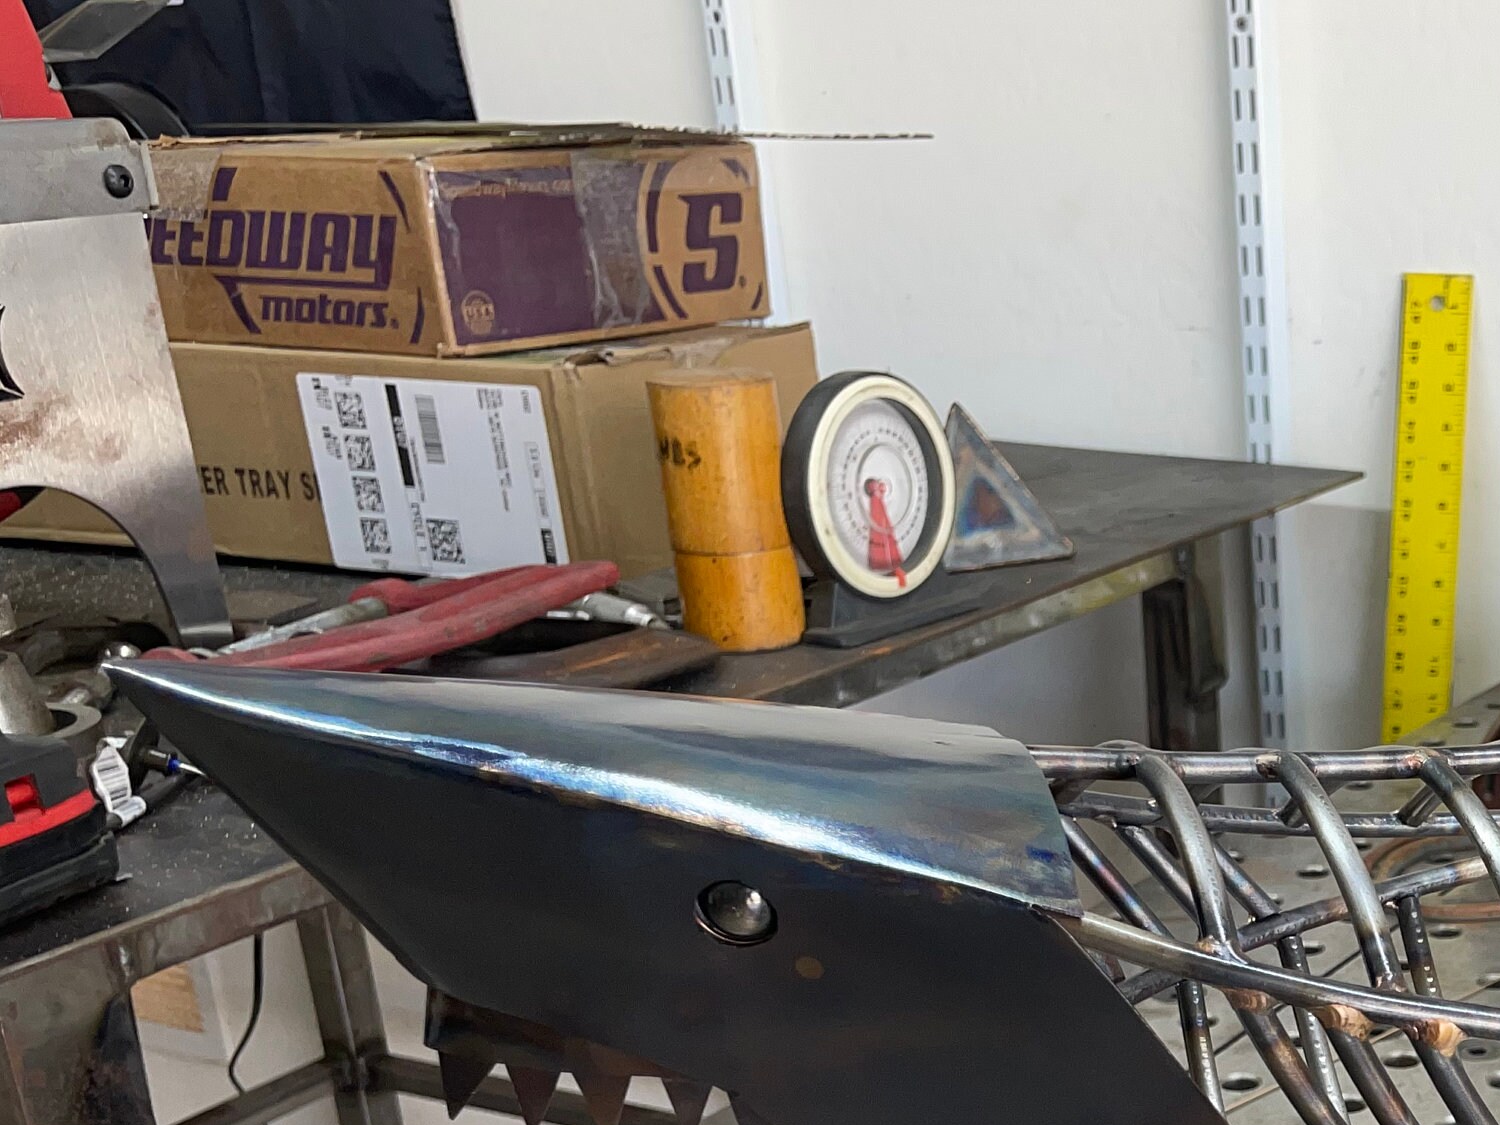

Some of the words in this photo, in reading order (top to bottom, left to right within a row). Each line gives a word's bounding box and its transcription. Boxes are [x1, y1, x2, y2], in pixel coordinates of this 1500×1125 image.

[144, 210, 397, 291] EEDWAY
[678, 193, 742, 294] S
[234, 467, 291, 499] TRAY
